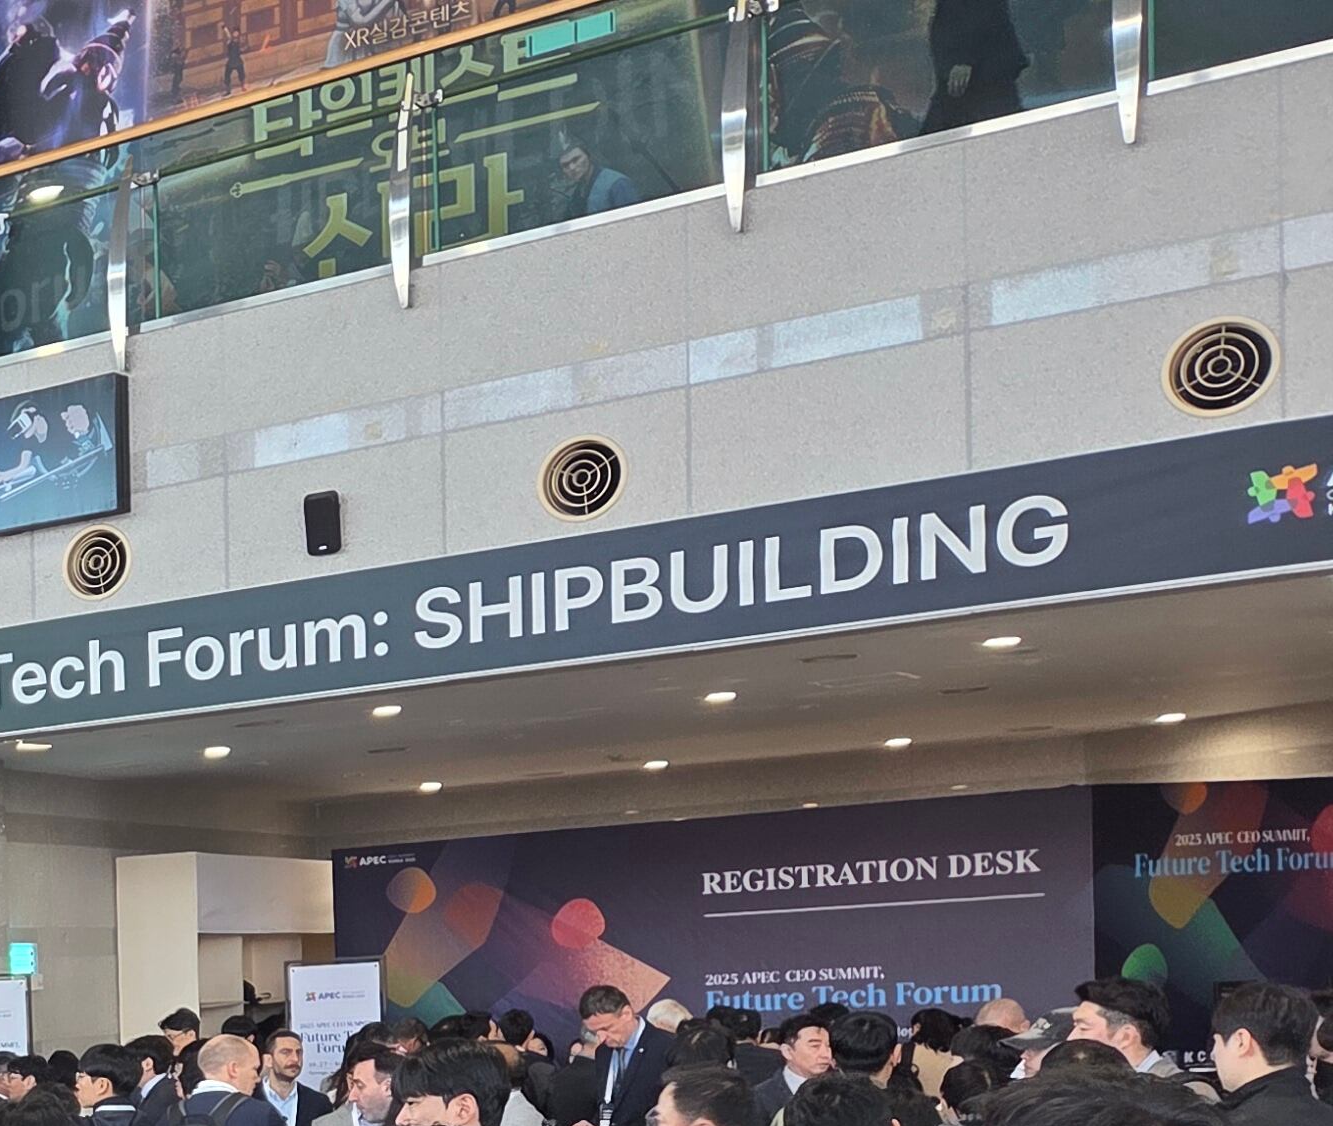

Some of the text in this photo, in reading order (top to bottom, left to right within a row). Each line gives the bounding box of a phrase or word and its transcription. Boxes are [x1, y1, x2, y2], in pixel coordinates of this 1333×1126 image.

[343, 2, 471, 51] XR실감콘텐츠
[148, 611, 389, 687] Forum:
[414, 494, 1069, 650] SHIPBUILDING
[1174, 828, 1311, 846] 2025 APEC CEO SUMMIT,
[701, 849, 1042, 896] REGISTRATION DESK
[1134, 846, 1333, 878] Future Tech Foru
[705, 966, 885, 987] 2025 APEC CEO SUMMIT,
[318, 991, 341, 1000] APEC
[705, 980, 1003, 1012] Future Tech Forum
